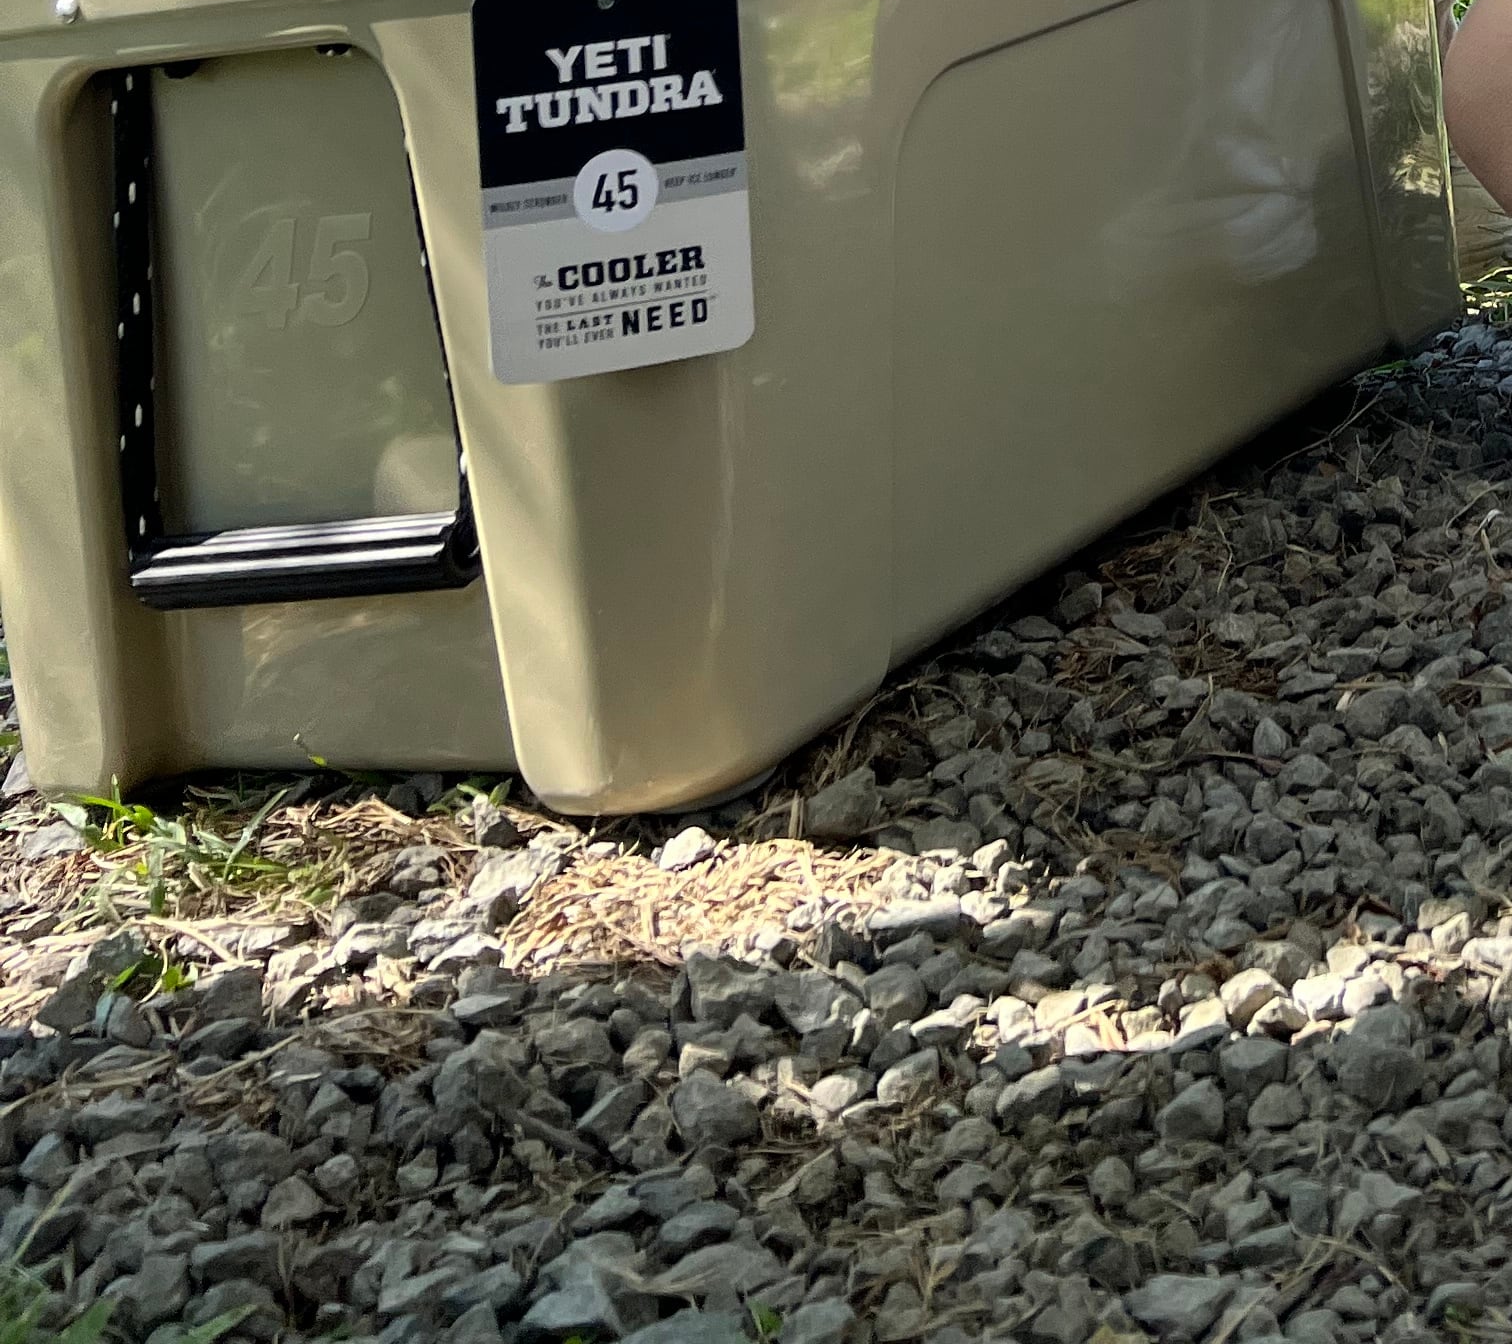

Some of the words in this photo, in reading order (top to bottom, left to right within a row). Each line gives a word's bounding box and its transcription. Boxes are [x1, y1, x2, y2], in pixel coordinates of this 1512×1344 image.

[545, 33, 669, 83] YETI
[496, 69, 723, 134] TUNDRA
[592, 169, 639, 213] 45
[236, 212, 372, 331] 45
[558, 245, 705, 291] COOLER
[535, 293, 585, 311] YOU'VE
[592, 283, 646, 303] ALWAYS
[653, 274, 708, 293] WANTED
[536, 321, 559, 336] THE
[566, 314, 614, 331] LAST
[622, 298, 708, 337] NEED
[538, 334, 578, 350] YOU'LL
[584, 328, 615, 344] EVER
